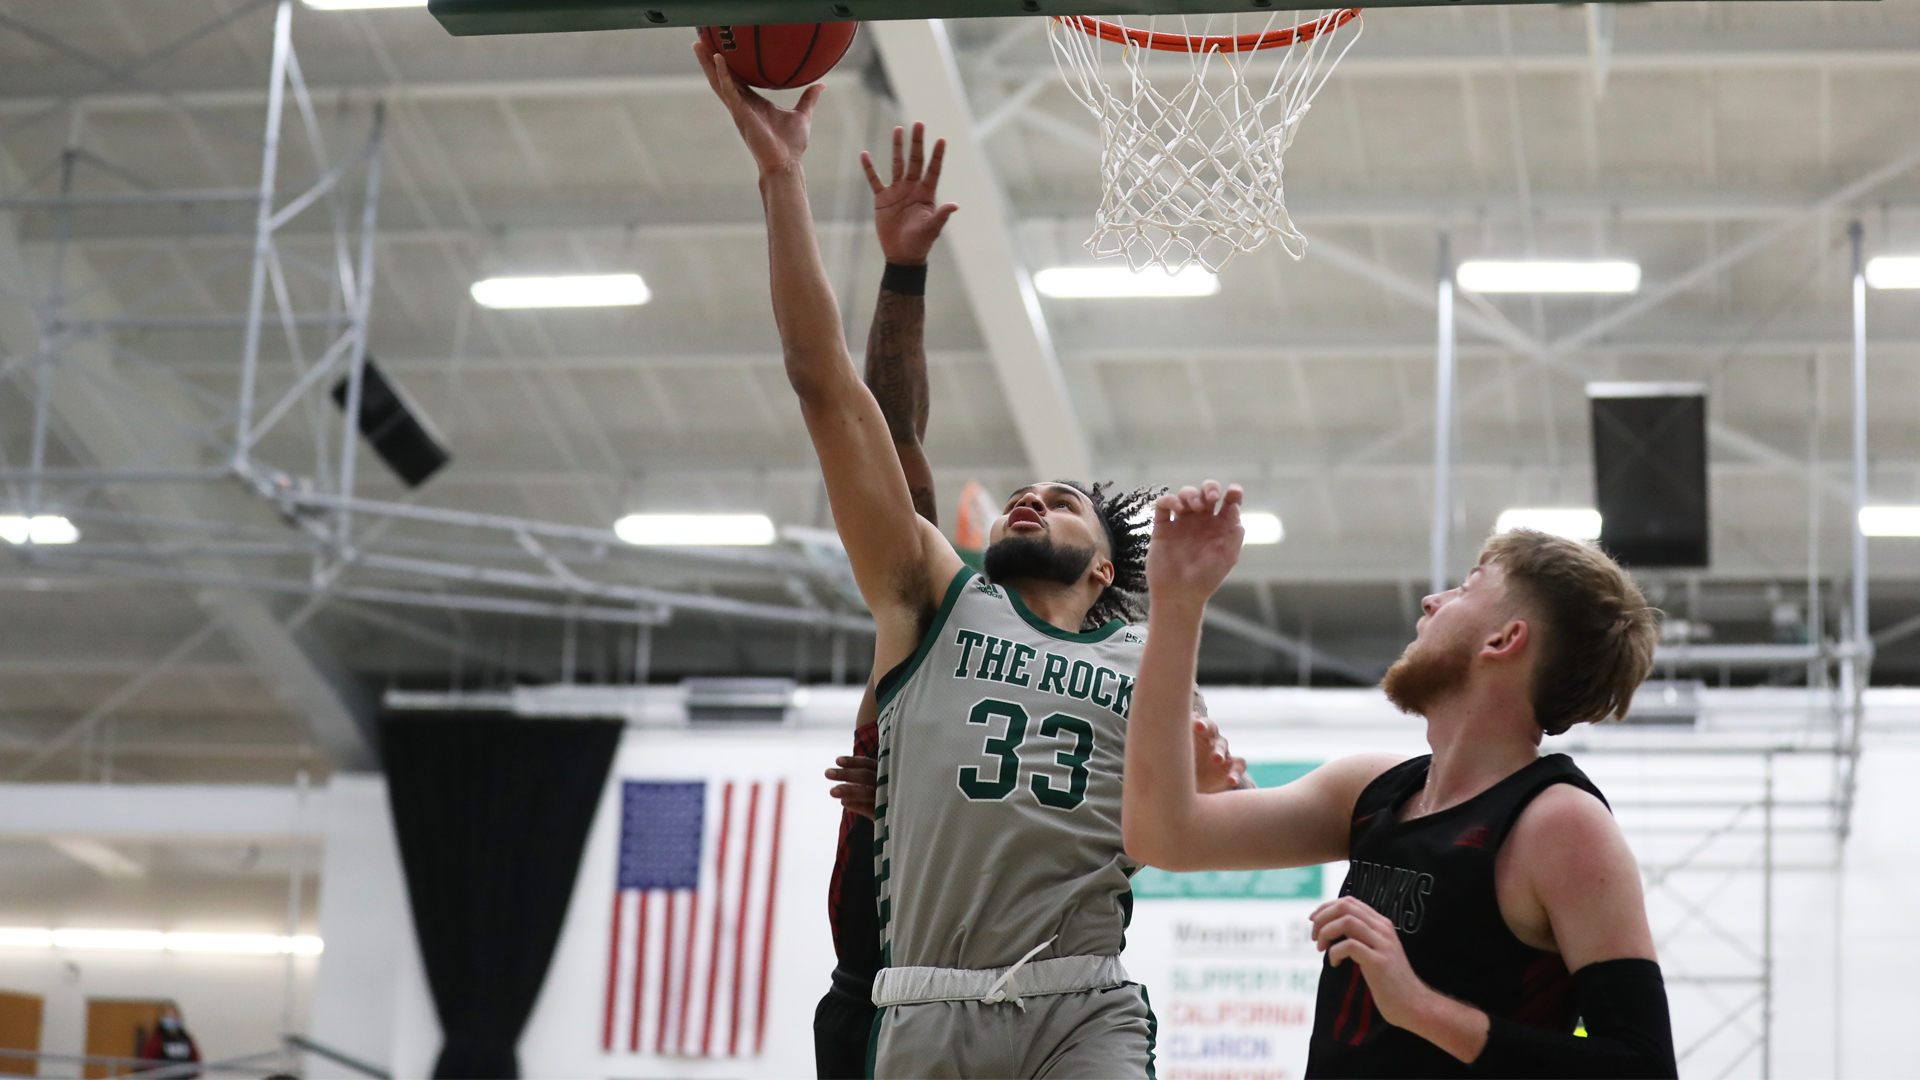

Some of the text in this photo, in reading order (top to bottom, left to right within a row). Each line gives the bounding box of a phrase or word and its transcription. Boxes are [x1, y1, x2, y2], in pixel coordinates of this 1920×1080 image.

[953, 628, 1138, 721] THE ROCK
[956, 696, 1095, 812] 33
